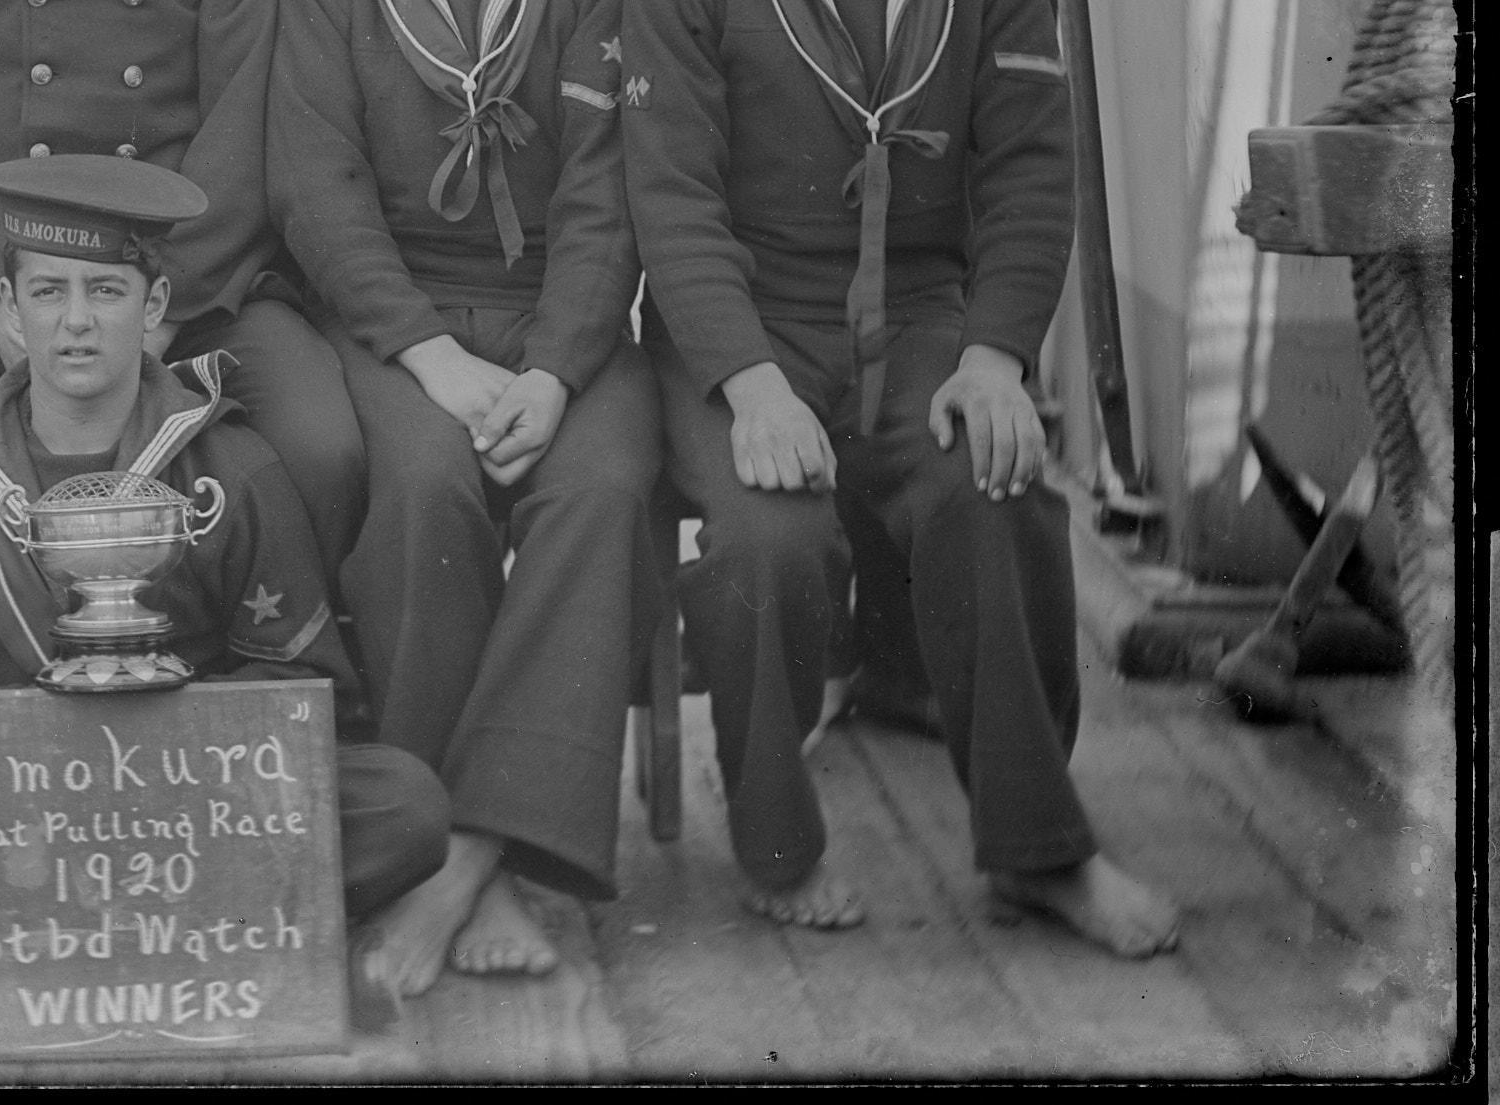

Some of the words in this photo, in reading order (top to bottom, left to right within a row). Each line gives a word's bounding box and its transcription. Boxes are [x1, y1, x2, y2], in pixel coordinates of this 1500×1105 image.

[44, 806, 200, 857] Pulling
[208, 799, 307, 838] Race
[56, 852, 195, 903] 1920
[134, 906, 303, 963] Watch
[17, 979, 262, 1027] WINNERS
